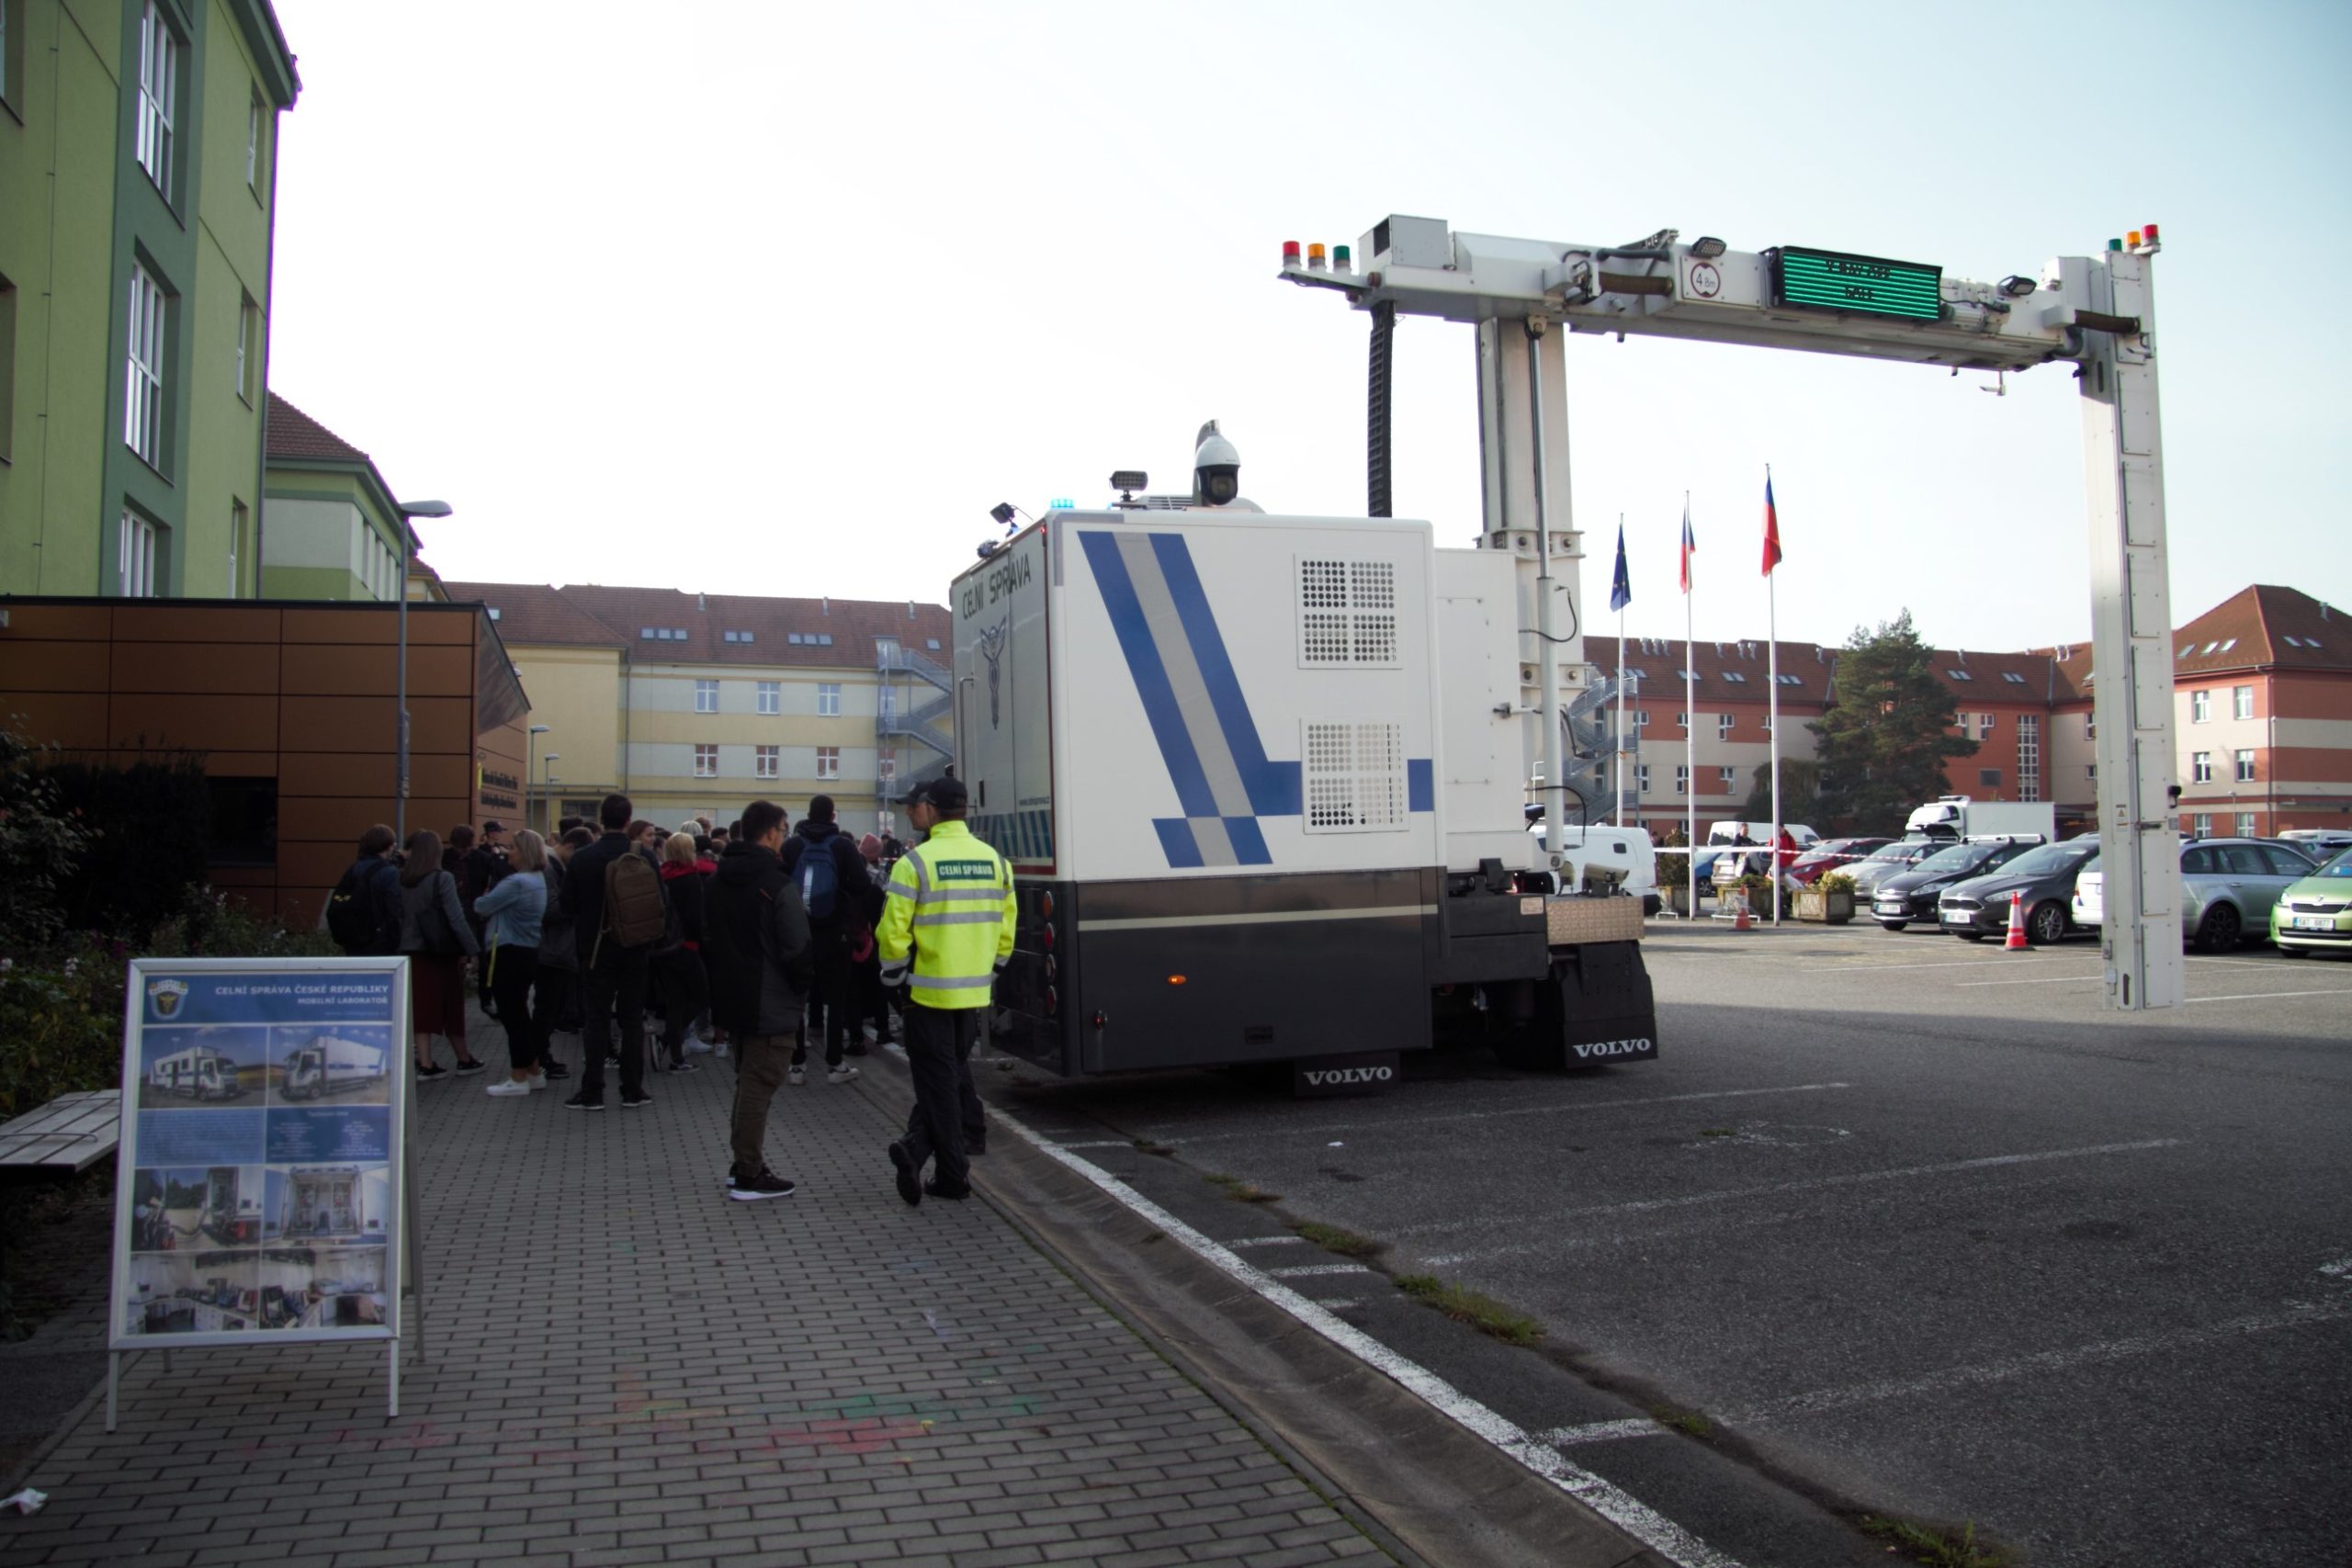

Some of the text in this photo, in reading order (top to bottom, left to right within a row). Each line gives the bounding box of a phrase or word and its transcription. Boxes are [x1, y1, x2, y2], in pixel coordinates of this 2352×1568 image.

[963, 552, 1031, 620] CELNÍ SPRÁVA
[939, 863, 993, 875] CELNÍ SPRÁVA
[215, 983, 389, 995] CELNÍ SPRÁVA ČESKÉ REPUBLIKY
[298, 995, 335, 1005] MOBILNÍ
[1573, 1038, 1651, 1058] VOLVO
[1304, 1066, 1393, 1086] VOLVO
